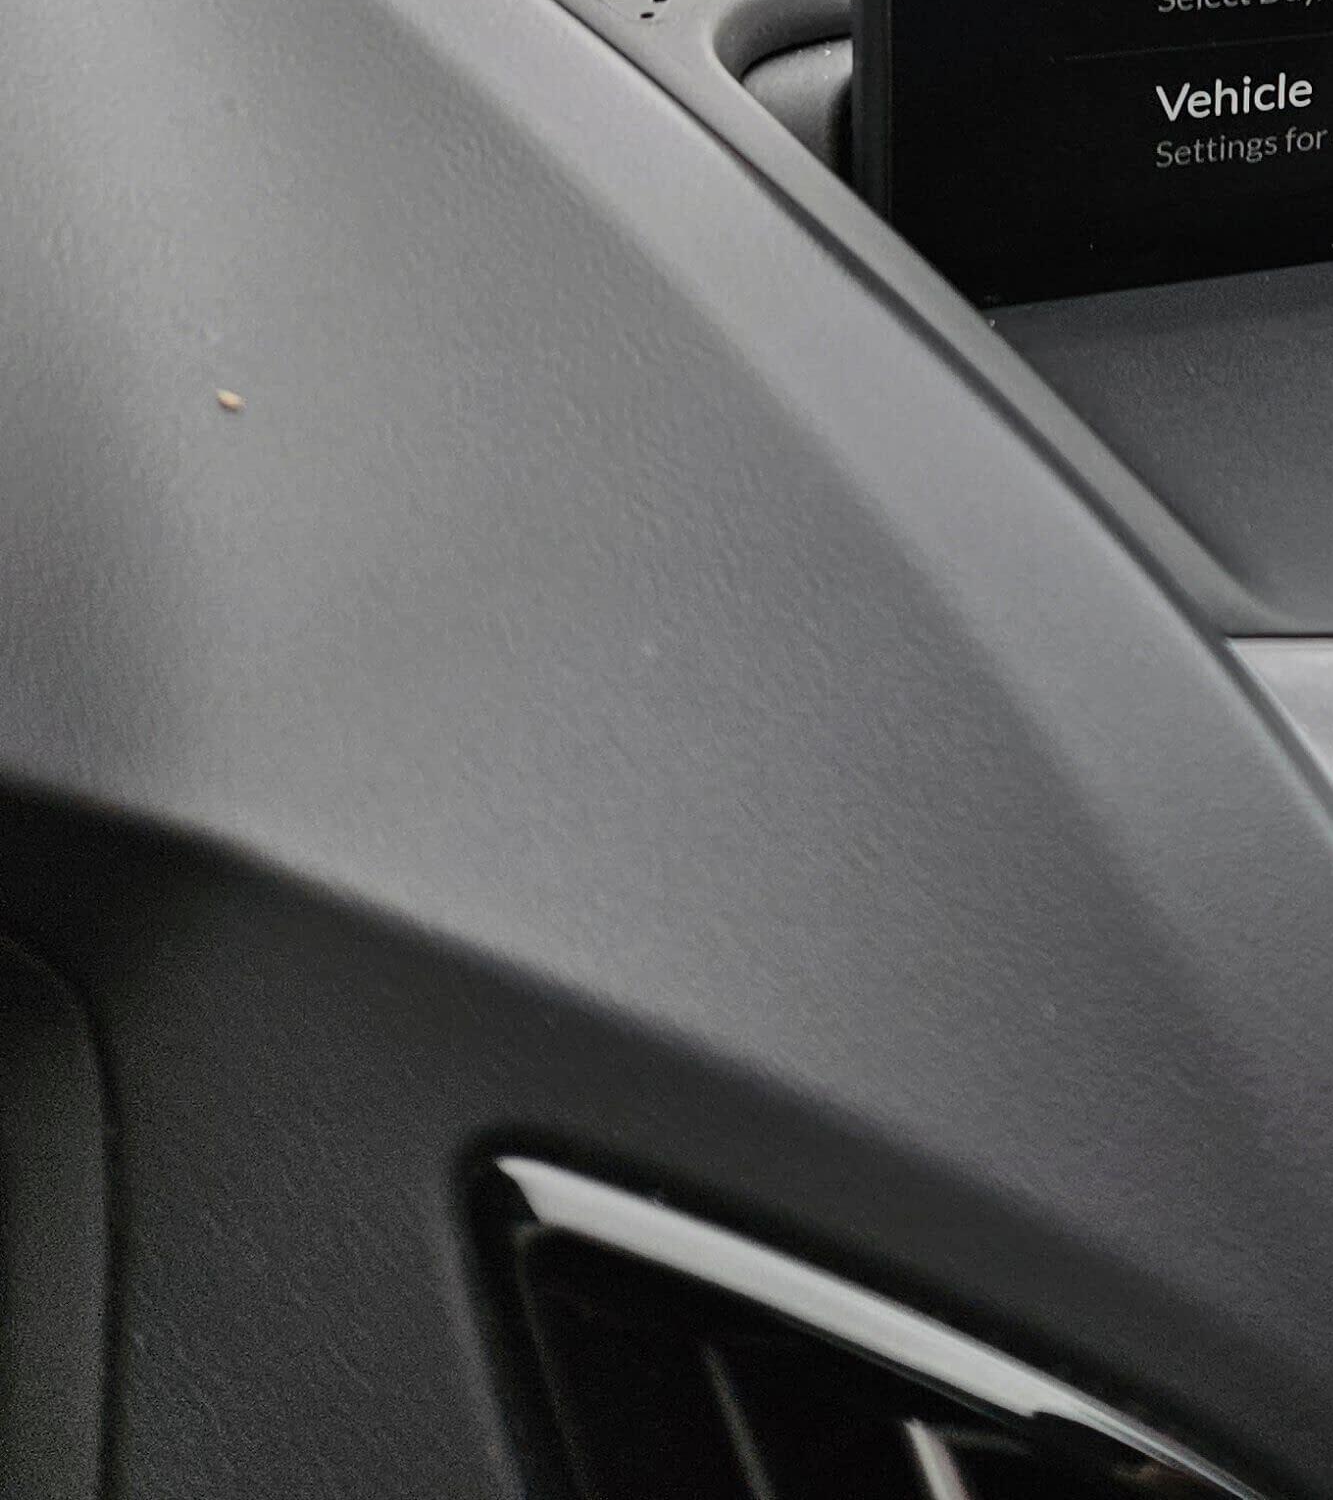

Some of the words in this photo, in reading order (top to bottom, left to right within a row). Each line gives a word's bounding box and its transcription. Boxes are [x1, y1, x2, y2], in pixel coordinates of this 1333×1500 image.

[1155, 71, 1314, 123] Vehicle
[1155, 134, 1279, 168] Settings
[1284, 125, 1329, 154] for
